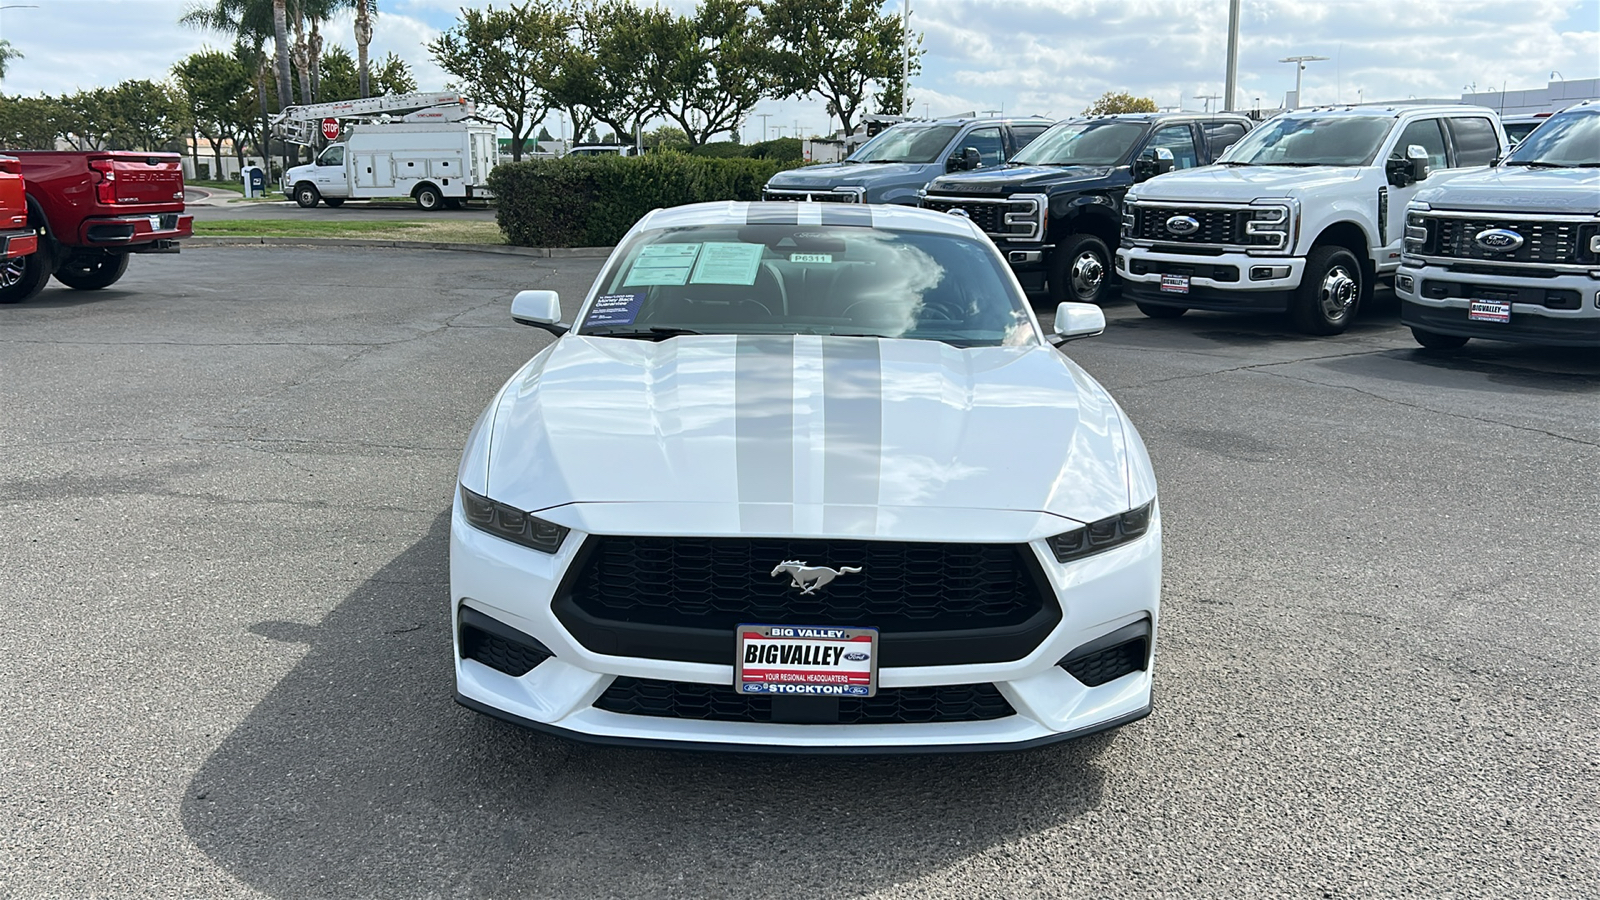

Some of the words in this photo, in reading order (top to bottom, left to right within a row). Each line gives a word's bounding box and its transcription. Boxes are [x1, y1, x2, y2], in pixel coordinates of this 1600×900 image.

[323, 123, 338, 133] STOP
[1486, 234, 1509, 245] Ford
[1472, 304, 1502, 313] BIGVALLEY
[771, 628, 794, 636] BIG
[797, 629, 844, 638] VALLEY
[744, 644, 845, 666] BIGVALLEY
[765, 673, 780, 681] YOUR
[780, 673, 806, 682] REGIONAL
[807, 674, 849, 683] HEADQUARTERS
[768, 684, 843, 694] STOCKTON
